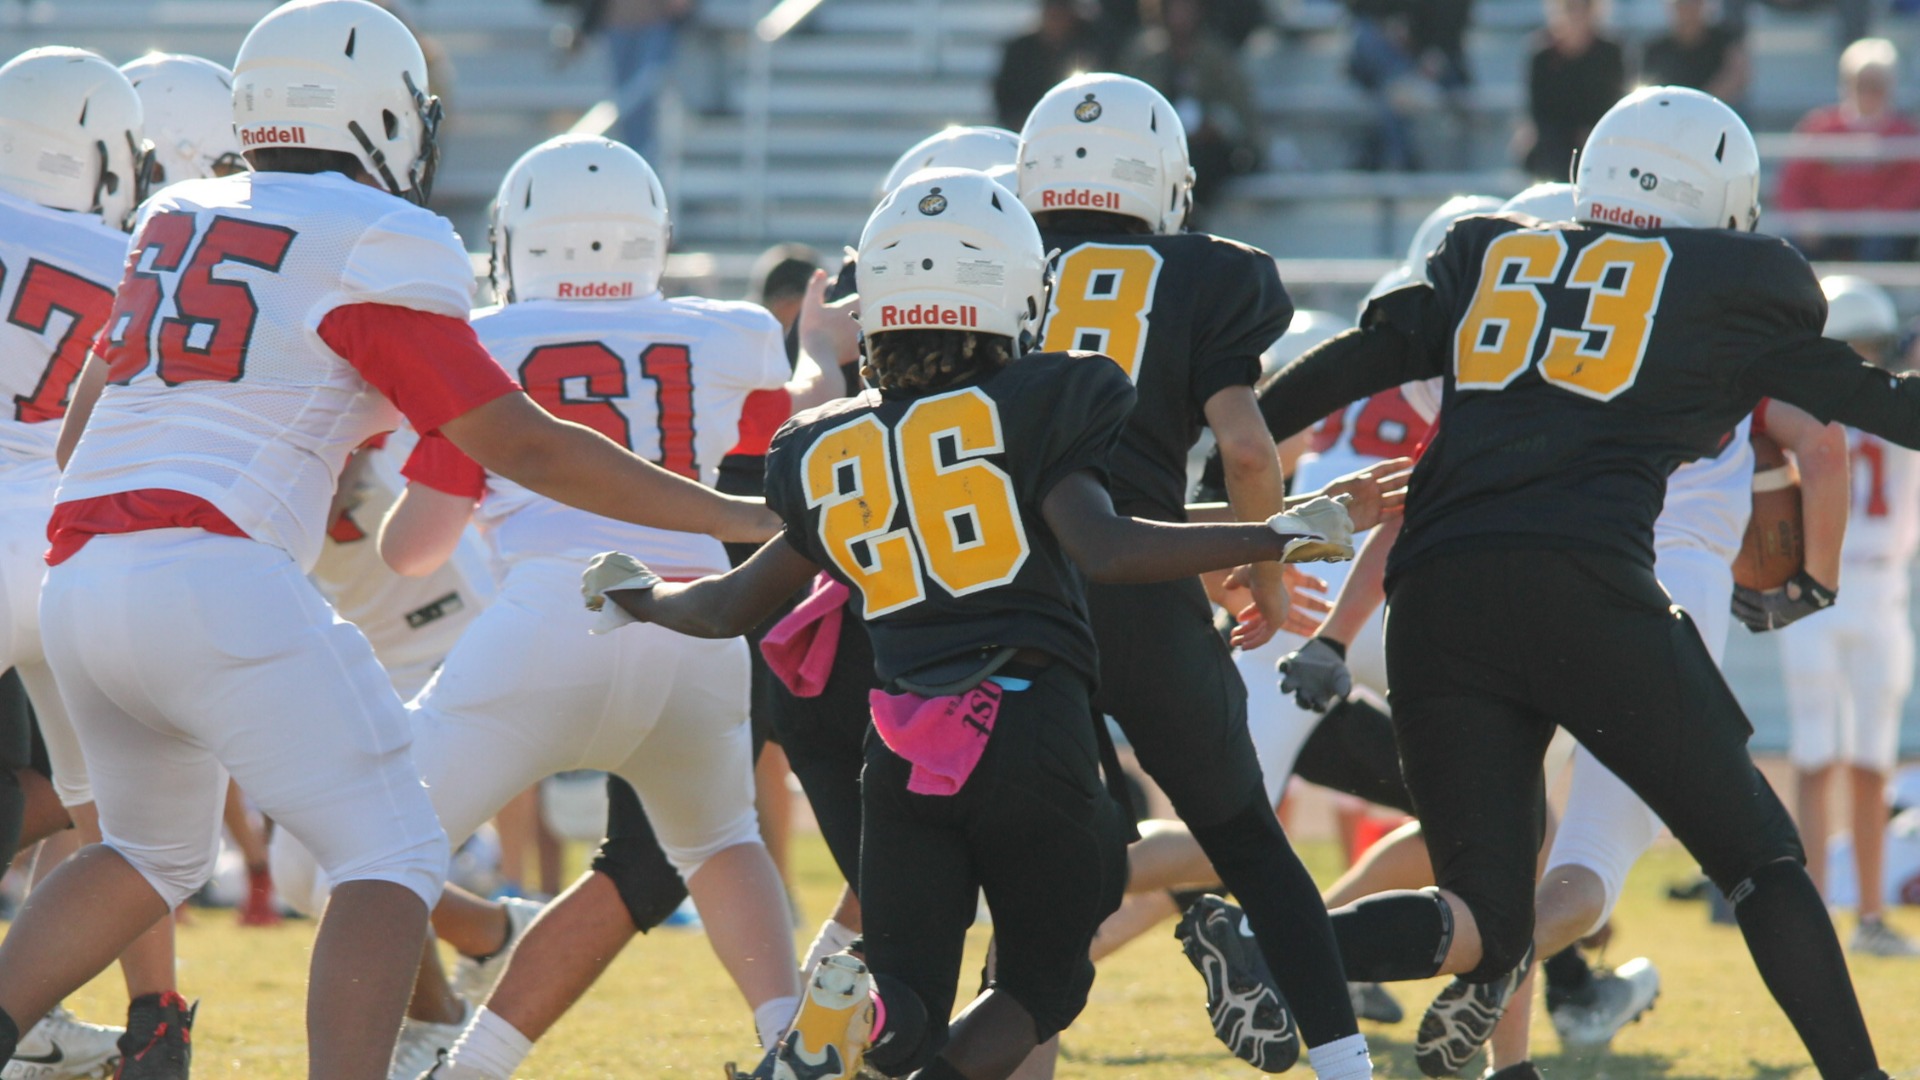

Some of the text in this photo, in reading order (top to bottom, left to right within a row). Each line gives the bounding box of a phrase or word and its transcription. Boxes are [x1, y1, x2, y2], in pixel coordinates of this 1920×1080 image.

[241, 126, 306, 146] Riddell
[1042, 189, 1120, 210] Riddell
[1590, 203, 1662, 229] Riddell
[106, 211, 299, 387] 65
[558, 282, 633, 298] Riddell
[881, 304, 977, 328] Riddell
[1042, 242, 1165, 387] 8
[1454, 230, 1674, 403] 63
[0, 255, 117, 424] 7
[800, 385, 1031, 621] 26
